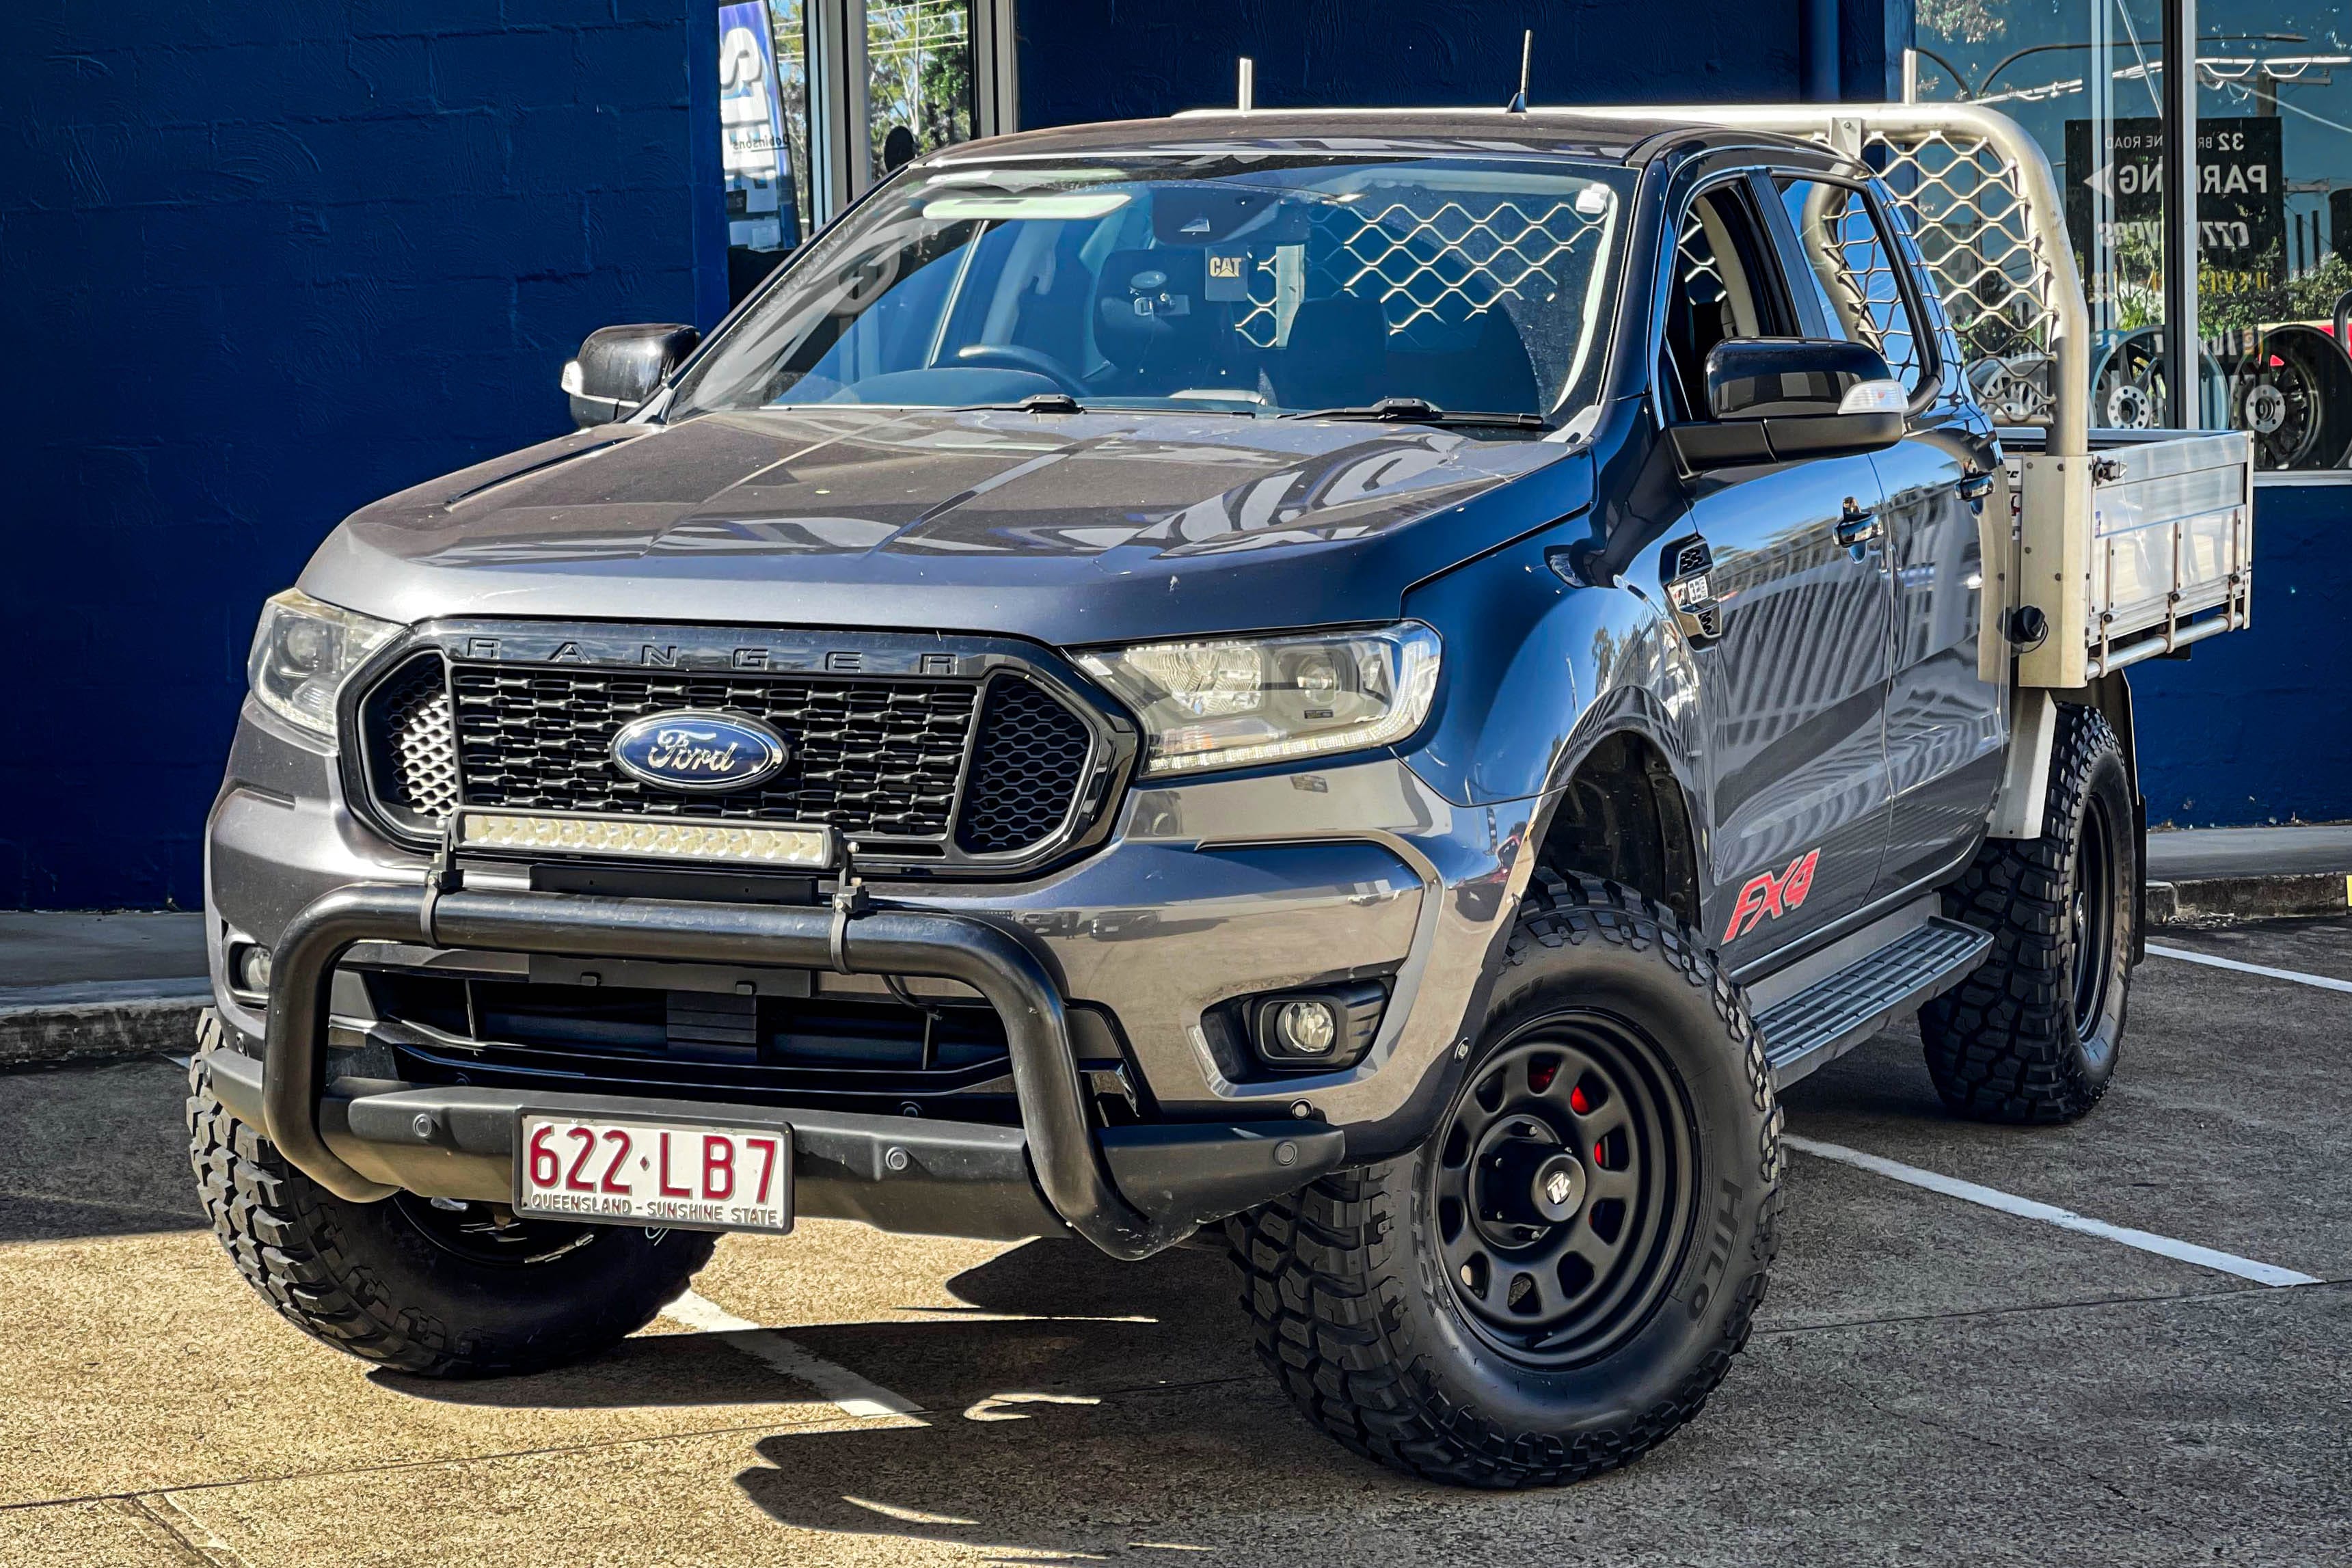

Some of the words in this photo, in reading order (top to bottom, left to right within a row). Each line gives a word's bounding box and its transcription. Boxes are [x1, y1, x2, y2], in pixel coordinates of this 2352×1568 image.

[1210, 257, 1242, 278] CAT
[466, 637, 958, 675] RANGER
[647, 729, 737, 772] Ford
[1720, 847, 1821, 946] FX4
[532, 1193, 632, 1215] QUEENSLAND
[647, 1201, 723, 1221] SUNSHINE
[731, 1207, 778, 1225] STATE
